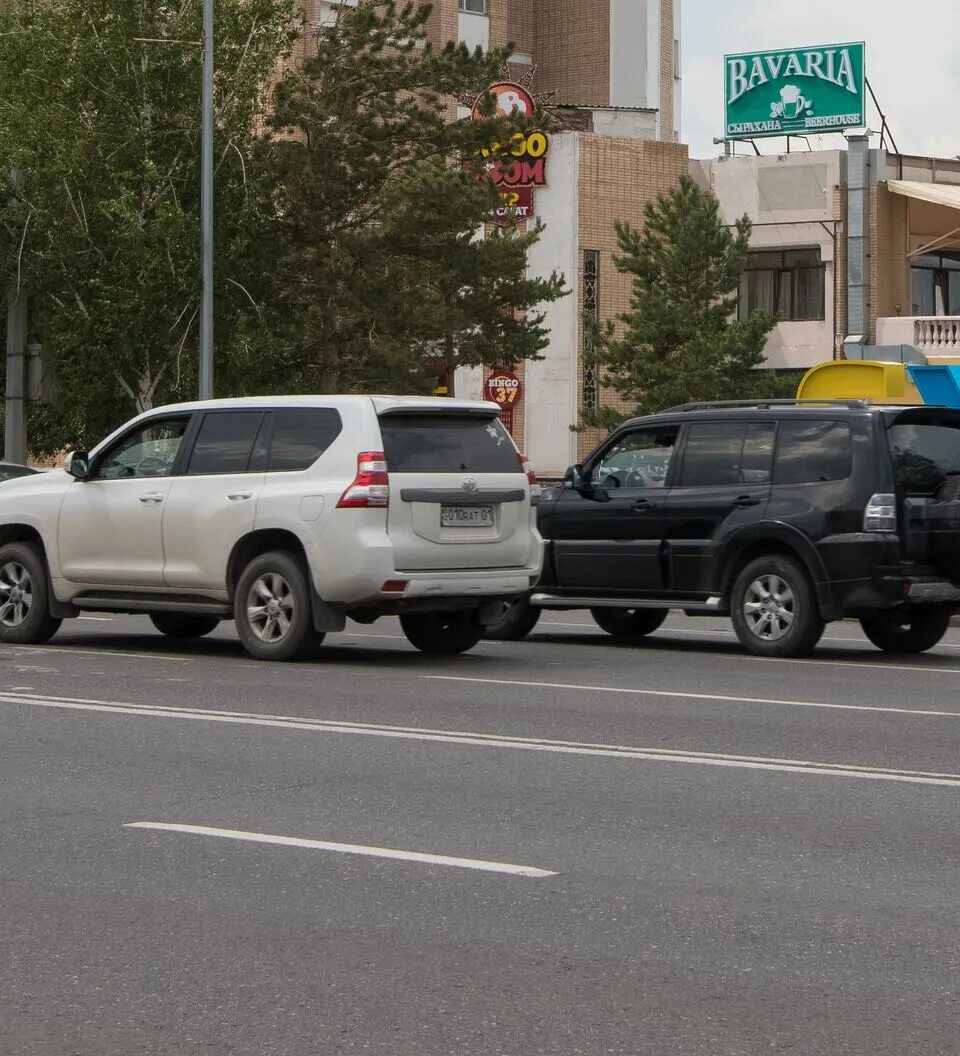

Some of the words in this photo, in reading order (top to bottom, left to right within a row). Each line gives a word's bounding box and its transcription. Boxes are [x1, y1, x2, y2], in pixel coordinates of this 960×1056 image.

[727, 48, 857, 105] BAVARIA
[727, 120, 782, 134] СЫРАХАНА
[804, 113, 861, 128] BEERHOUSE
[488, 379, 519, 387] BINGO
[495, 387, 518, 403] 37
